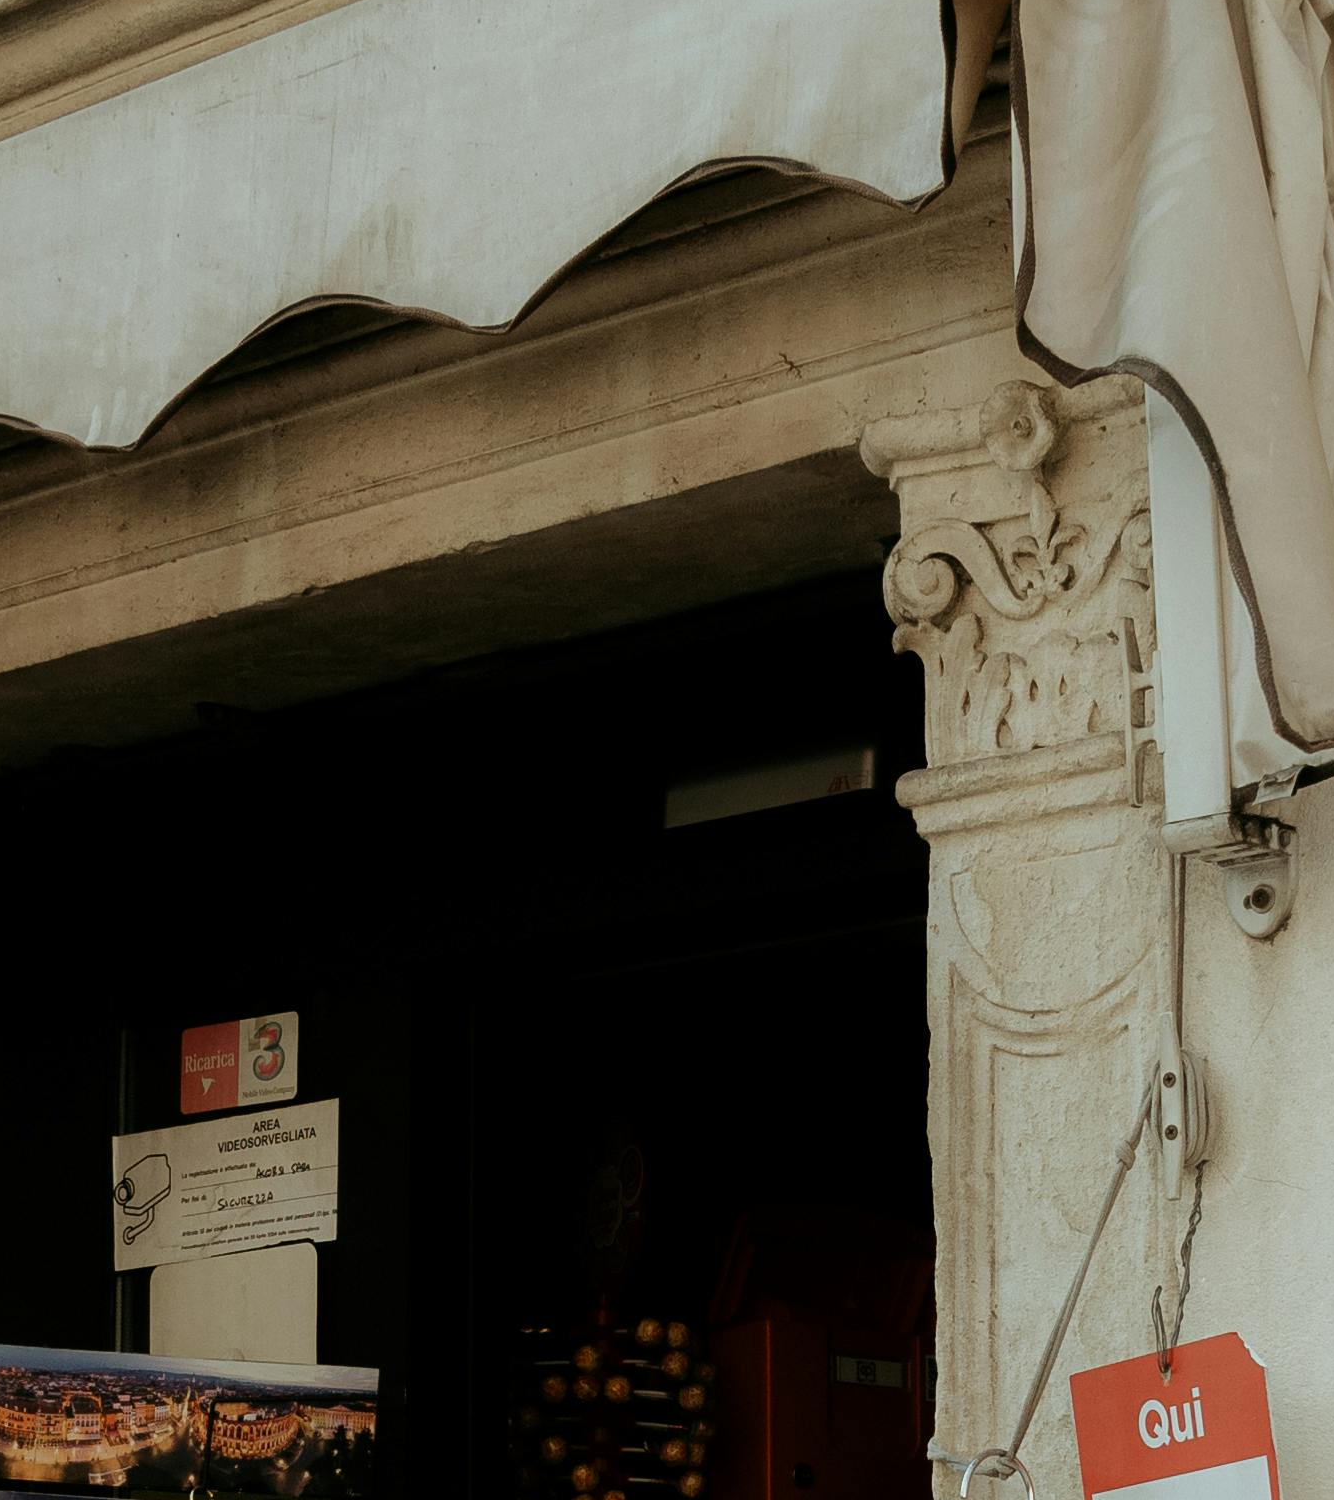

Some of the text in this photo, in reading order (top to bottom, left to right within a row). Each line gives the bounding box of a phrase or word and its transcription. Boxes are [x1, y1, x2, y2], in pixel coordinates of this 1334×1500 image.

[185, 1021, 285, 1081] Ricarica 3
[218, 1127, 316, 1153] VIDEOSORVEGLIATA
[253, 1119, 280, 1133] AREA
[1138, 1386, 1205, 1449] Qui
